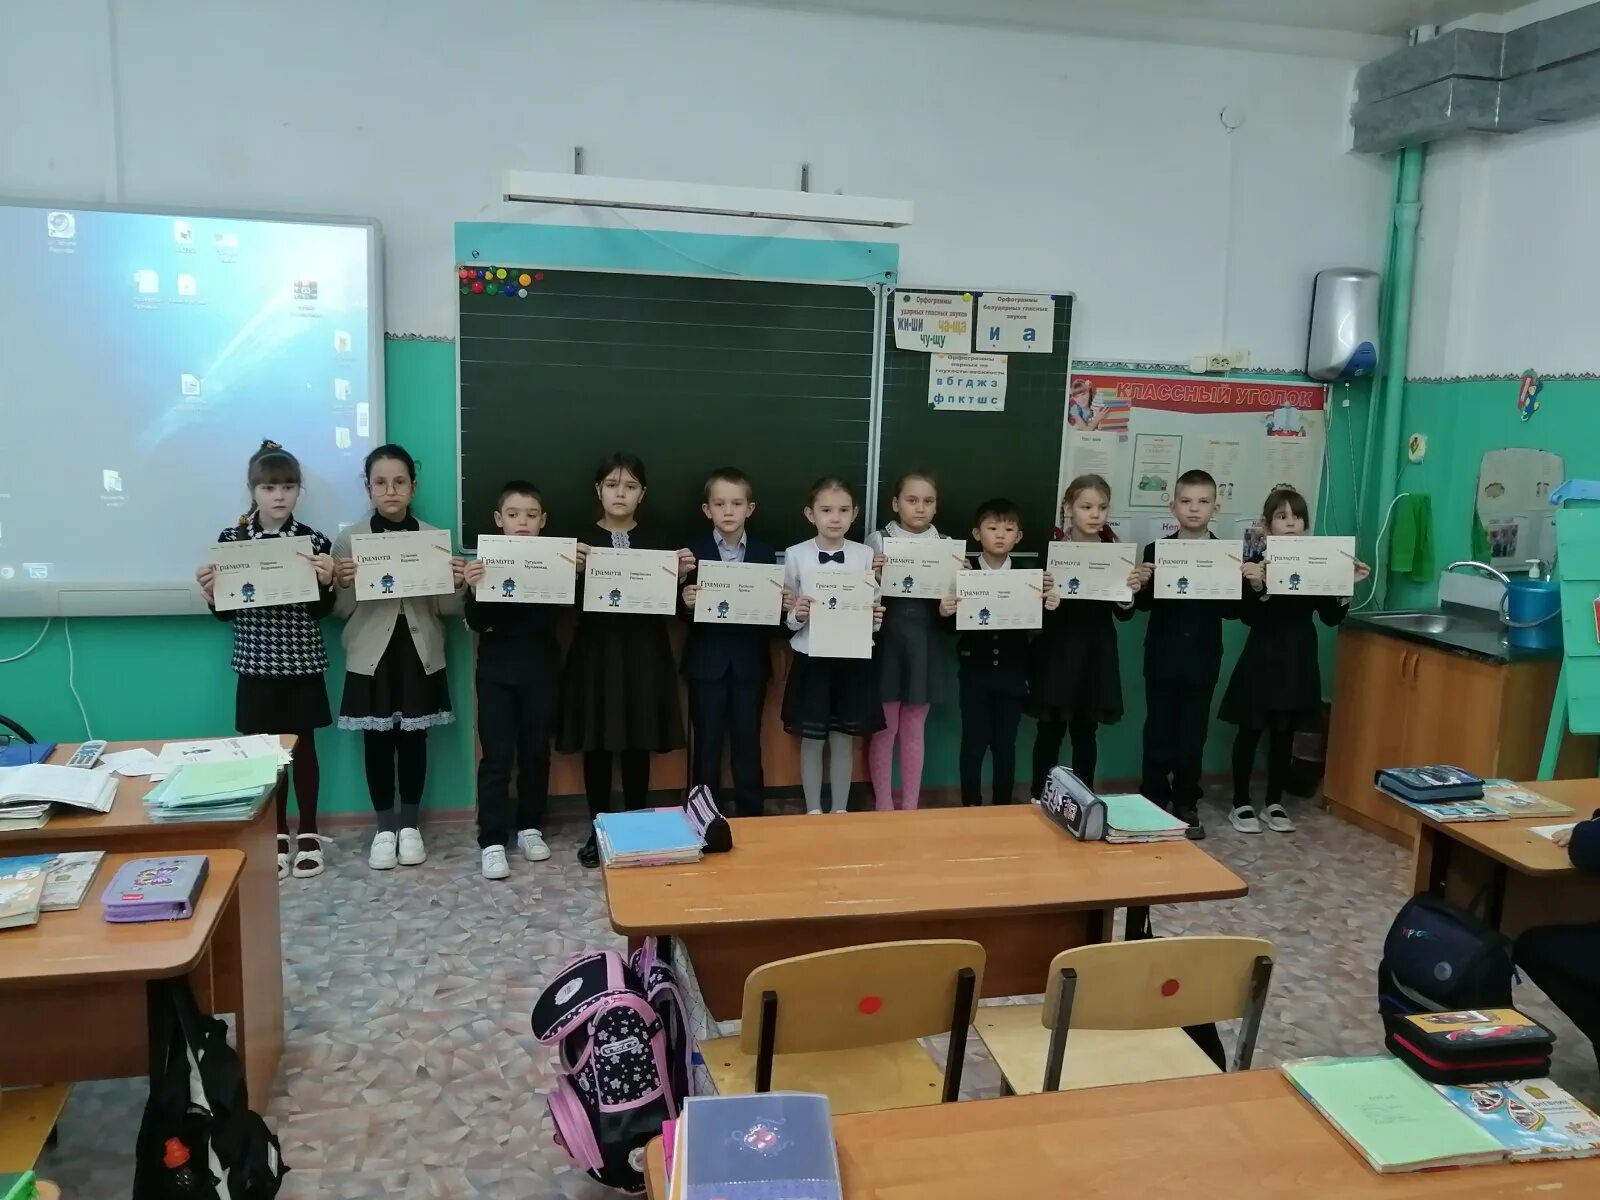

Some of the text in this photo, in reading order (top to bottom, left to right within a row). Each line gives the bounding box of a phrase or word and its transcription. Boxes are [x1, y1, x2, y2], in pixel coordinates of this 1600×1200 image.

[989, 326, 1037, 342] и а
[946, 376, 954, 386] б
[965, 379, 974, 389] д
[976, 379, 987, 387] ж
[948, 395, 955, 403] п
[967, 396, 975, 404] т
[977, 396, 988, 404] ш
[1116, 381, 1314, 408] КЛАССНЫЙ УГОЛОК
[357, 554, 392, 564] Грамота
[481, 555, 515, 566] Грамота
[886, 556, 915, 566] Грамота
[1050, 558, 1081, 569] Грамота
[1158, 556, 1189, 567] Грамота
[1270, 553, 1301, 563] Грамота
[213, 560, 251, 573] Грамота
[590, 567, 622, 578] Грамота
[700, 579, 731, 590] Грамота
[960, 588, 990, 599] Грамота
